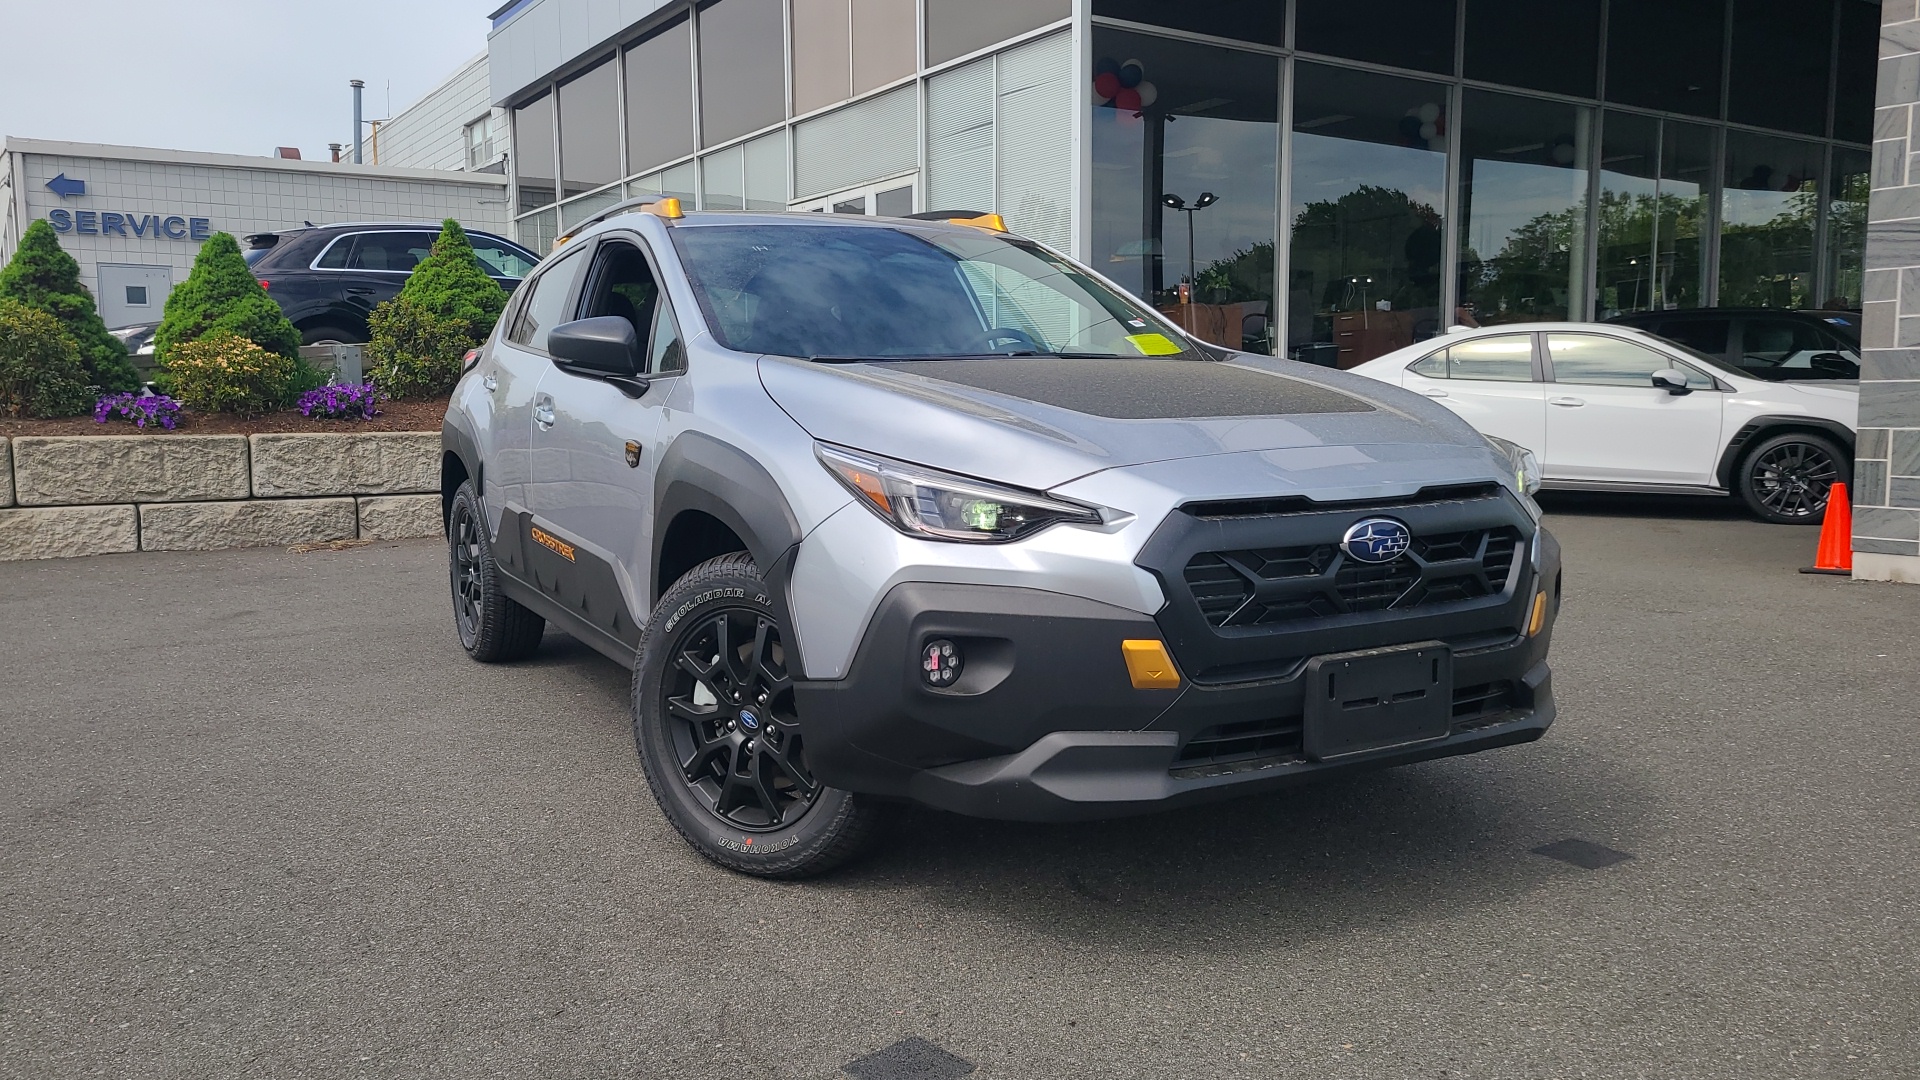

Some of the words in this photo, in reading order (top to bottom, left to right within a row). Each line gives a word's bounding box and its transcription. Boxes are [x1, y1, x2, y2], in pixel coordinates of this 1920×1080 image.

[49, 208, 211, 241] SERVICE
[531, 527, 576, 562] CROSSTREK
[664, 587, 745, 633] GEOLANDAR
[718, 834, 800, 855] YOKOHAMA
